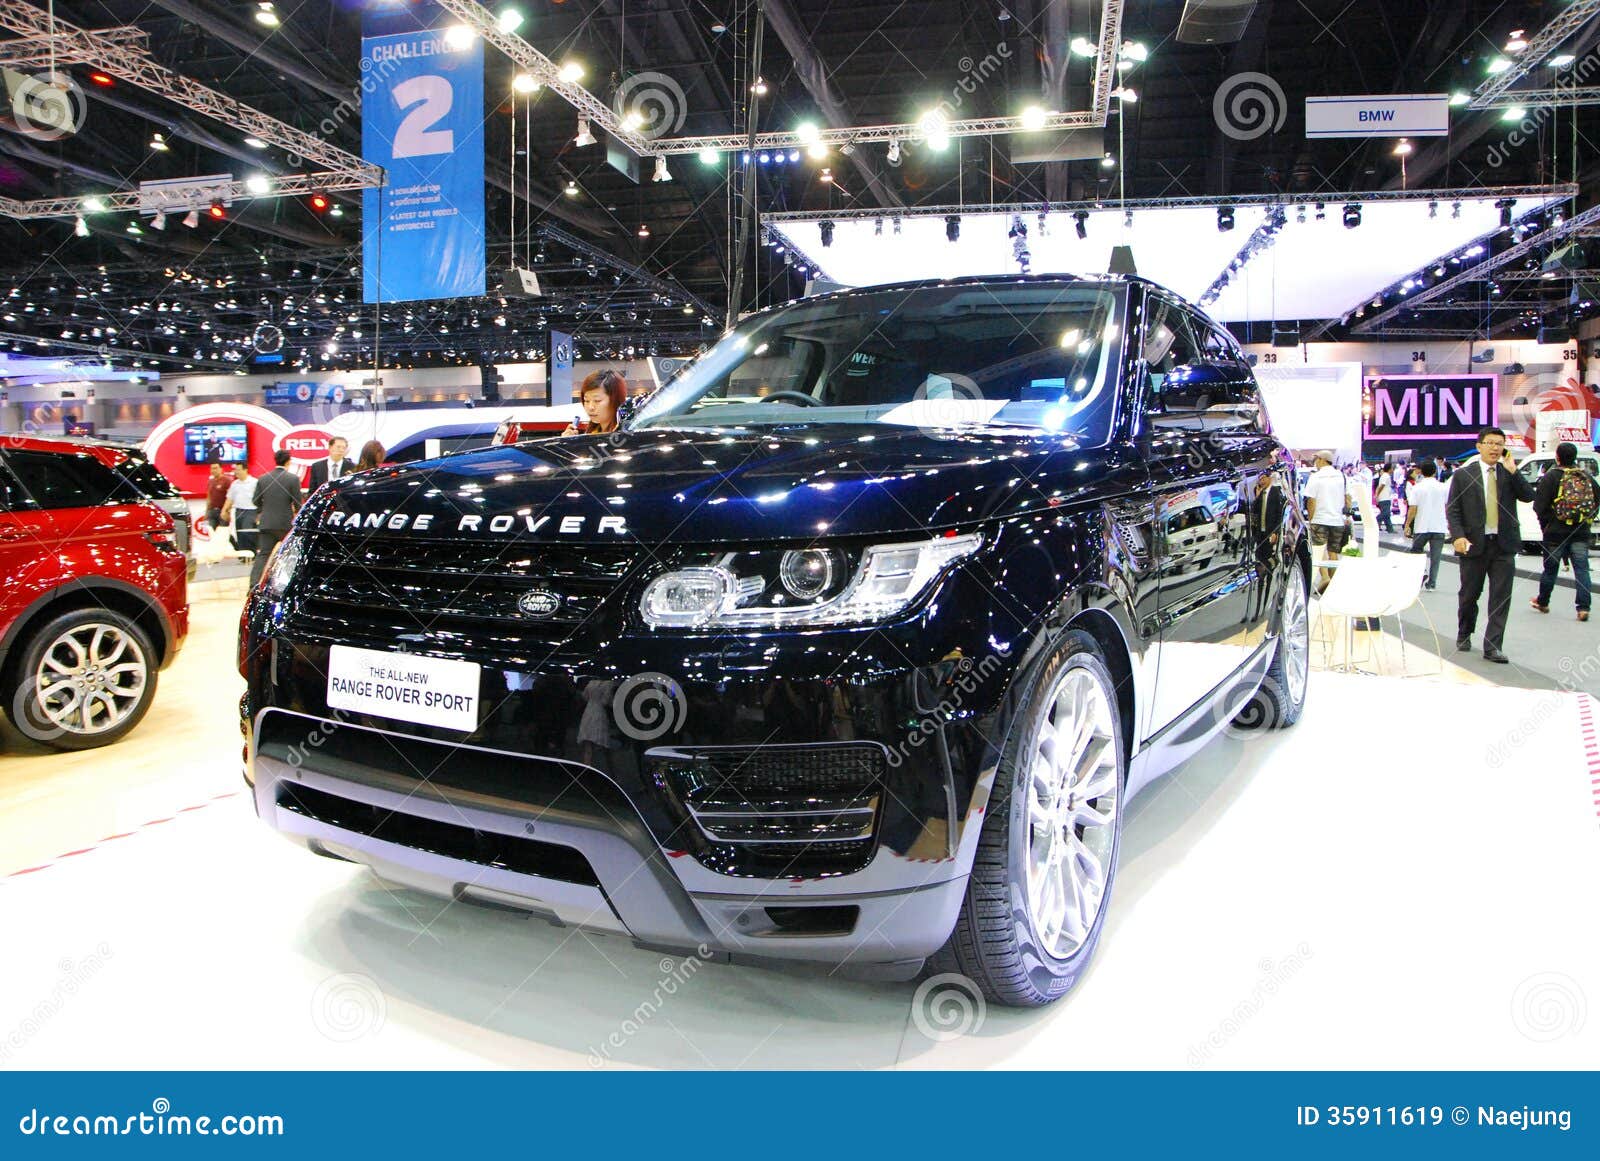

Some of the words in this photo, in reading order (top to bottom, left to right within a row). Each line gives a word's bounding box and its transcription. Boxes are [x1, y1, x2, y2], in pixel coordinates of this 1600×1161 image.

[392, 75, 454, 159] 2
[1358, 110, 1395, 121] BMW
[418, 210, 431, 218] CAR
[1264, 353, 1277, 363] 33
[1412, 351, 1425, 362] 34
[1563, 349, 1577, 360] 35
[1375, 386, 1488, 427] MINI
[285, 438, 330, 450] RELY
[326, 511, 434, 531] RANGE
[457, 514, 628, 535] ROVER
[526, 602, 552, 612] ROVER
[369, 667, 386, 679] THE
[387, 670, 429, 685] ALL-NEW
[332, 677, 372, 697] RANGE
[375, 684, 420, 705] ROVER
[424, 691, 473, 713] SPORT
